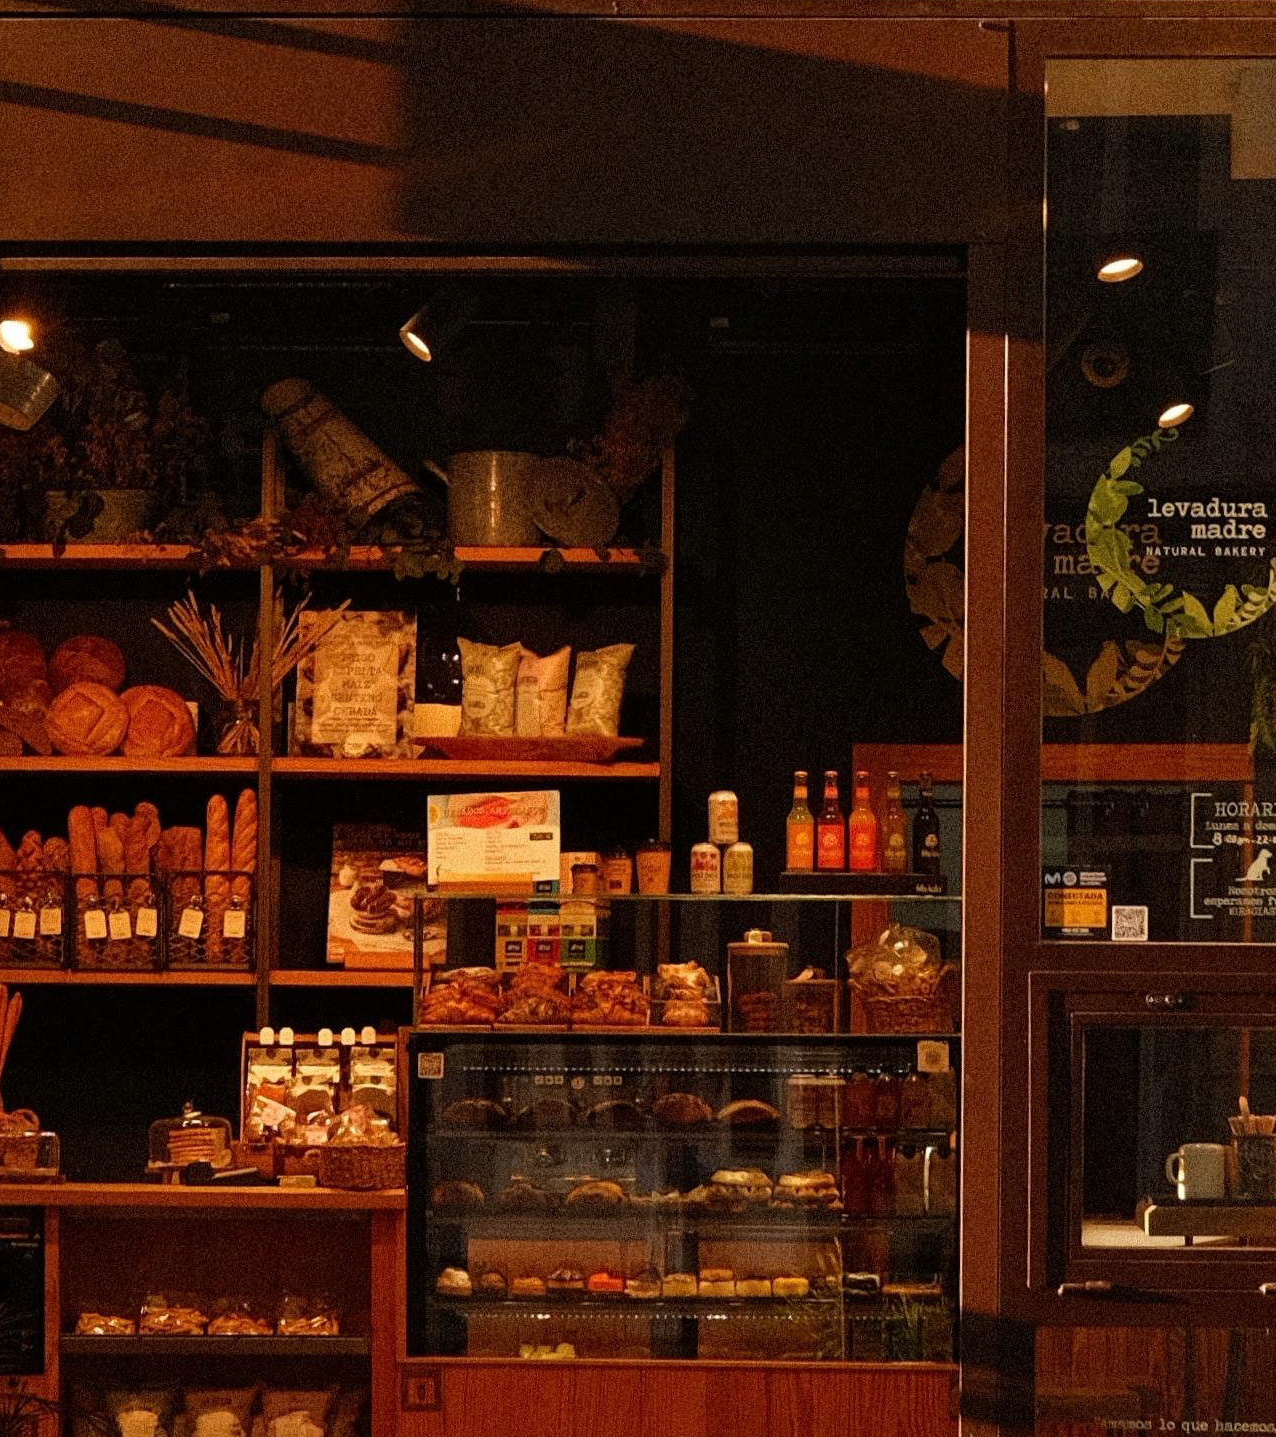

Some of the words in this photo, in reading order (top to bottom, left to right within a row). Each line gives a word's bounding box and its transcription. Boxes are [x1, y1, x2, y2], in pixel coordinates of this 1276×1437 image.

[1147, 497, 1269, 518] levadura
[1191, 519, 1266, 539] madre
[1146, 546, 1205, 557] NATURAL
[1215, 546, 1266, 557] BAKERY
